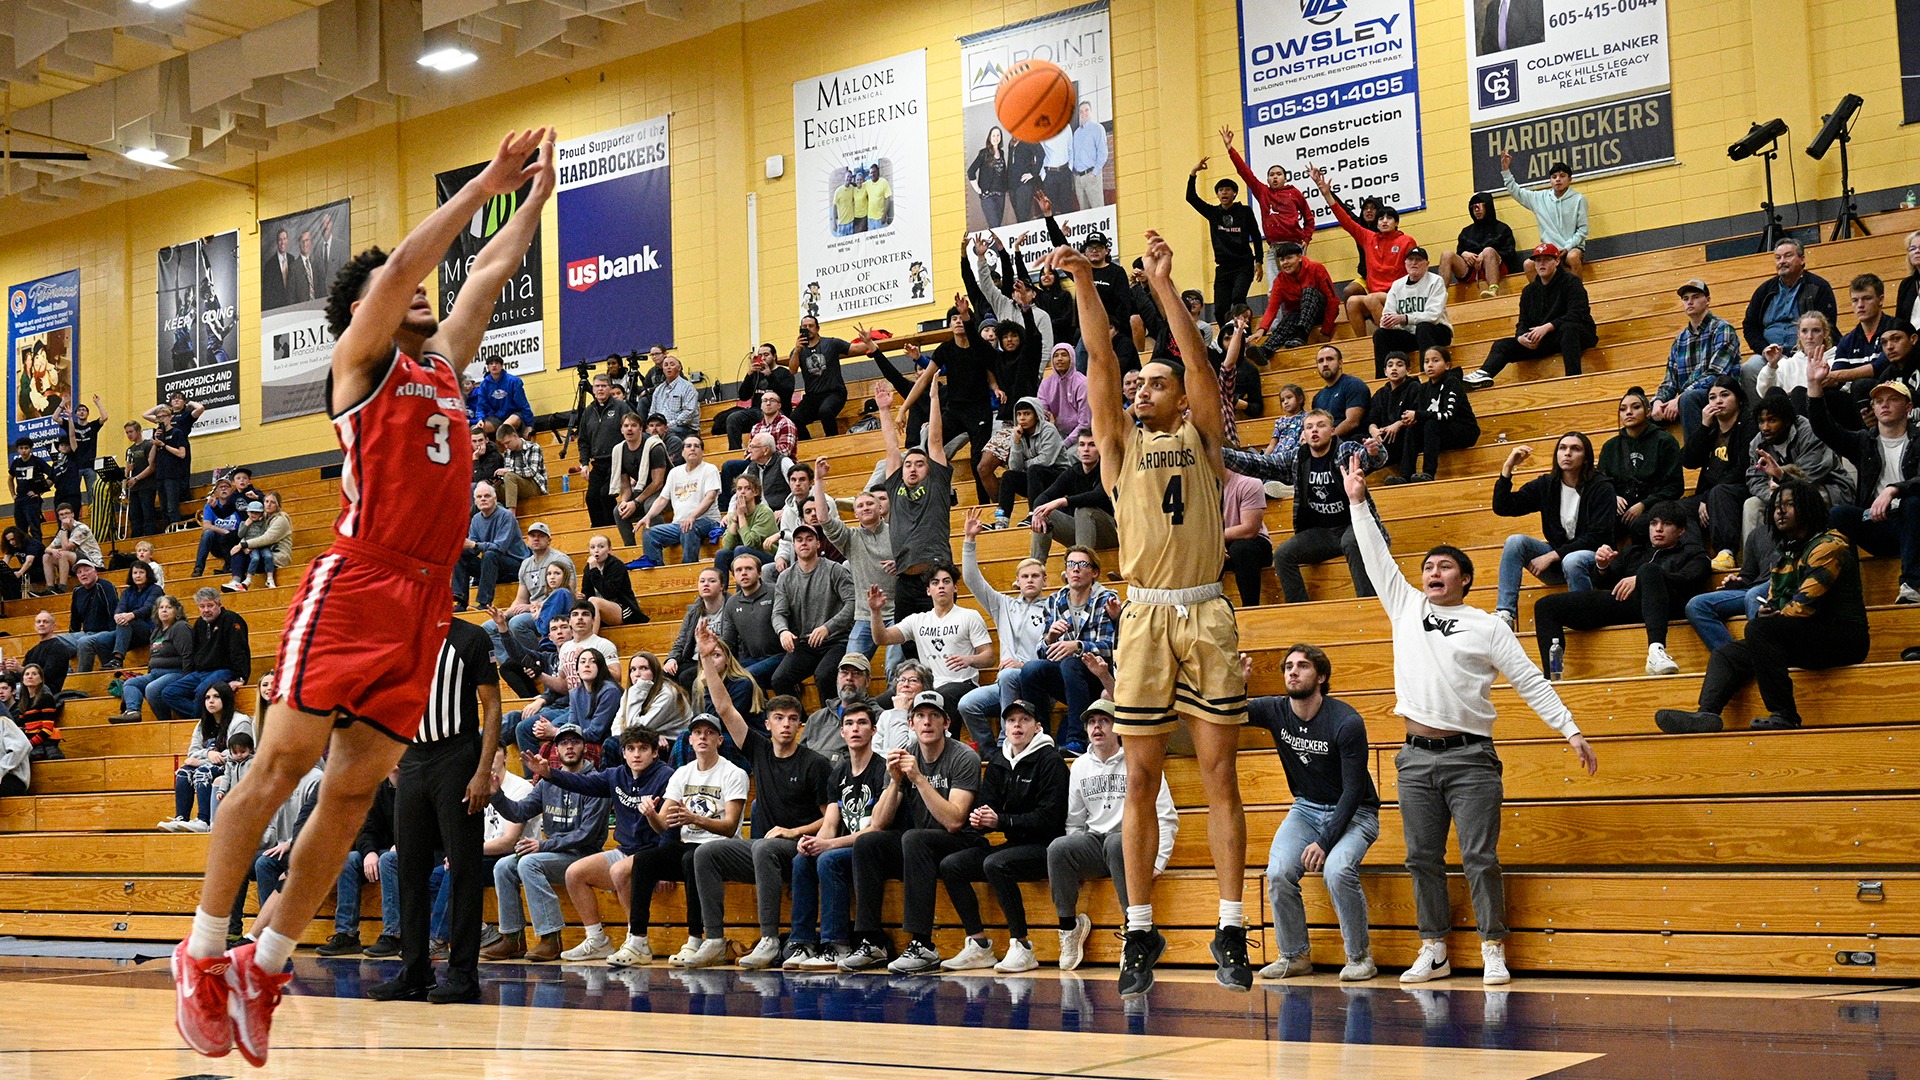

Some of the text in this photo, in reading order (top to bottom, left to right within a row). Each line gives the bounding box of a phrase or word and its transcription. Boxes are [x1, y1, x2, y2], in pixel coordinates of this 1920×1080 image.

[1013, 29, 1103, 64] POINT
[1251, 14, 1400, 67] OWSLEY
[1526, 34, 1659, 71] COLDWELL BANKER
[1062, 56, 1104, 72] DVISORS
[1253, 38, 1403, 83] CONSTRUCTION
[1253, 54, 1403, 93] BUILDING THE FUTURE. RESTORING THE PAST.
[1537, 53, 1650, 85] BLACK HILLS LEGACY
[816, 68, 895, 112] MALONE
[1559, 68, 1628, 89] REAL ESTATE
[1257, 76, 1404, 123] 605-391-4095
[803, 99, 918, 151] ENGINEERING
[1264, 110, 1402, 147] New Construction
[1488, 100, 1660, 157] HARDROCKERS
[560, 125, 665, 160] Proud Supporter of the
[1296, 136, 1370, 161] Remodels
[560, 142, 666, 185] HARDROCKERS
[1285, 165, 1328, 183] Decs
[1338, 153, 1388, 172] Patios
[1352, 172, 1400, 190] Doors
[1358, 192, 1401, 209] Mre
[1100, 218, 1110, 232] of
[816, 250, 913, 278] PROUD SUPPORTERS
[857, 271, 871, 282] OF
[830, 279, 899, 301] HARDROCKER
[837, 294, 893, 312] ATHLETICS!
[164, 306, 234, 332] KEEP GOING
[471, 336, 540, 364] ARDROCKERS
[490, 330, 519, 342] SUPPORTERS
[164, 370, 232, 392] ORTHOPEDICS AND
[195, 381, 232, 397] MEDICINE
[18, 424, 28, 432] Dr.
[28, 421, 44, 430] Laura
[210, 416, 238, 425] HEALTH
[426, 414, 450, 464] 3
[1162, 474, 1185, 526] 4
[920, 625, 960, 637] GAME DAY
